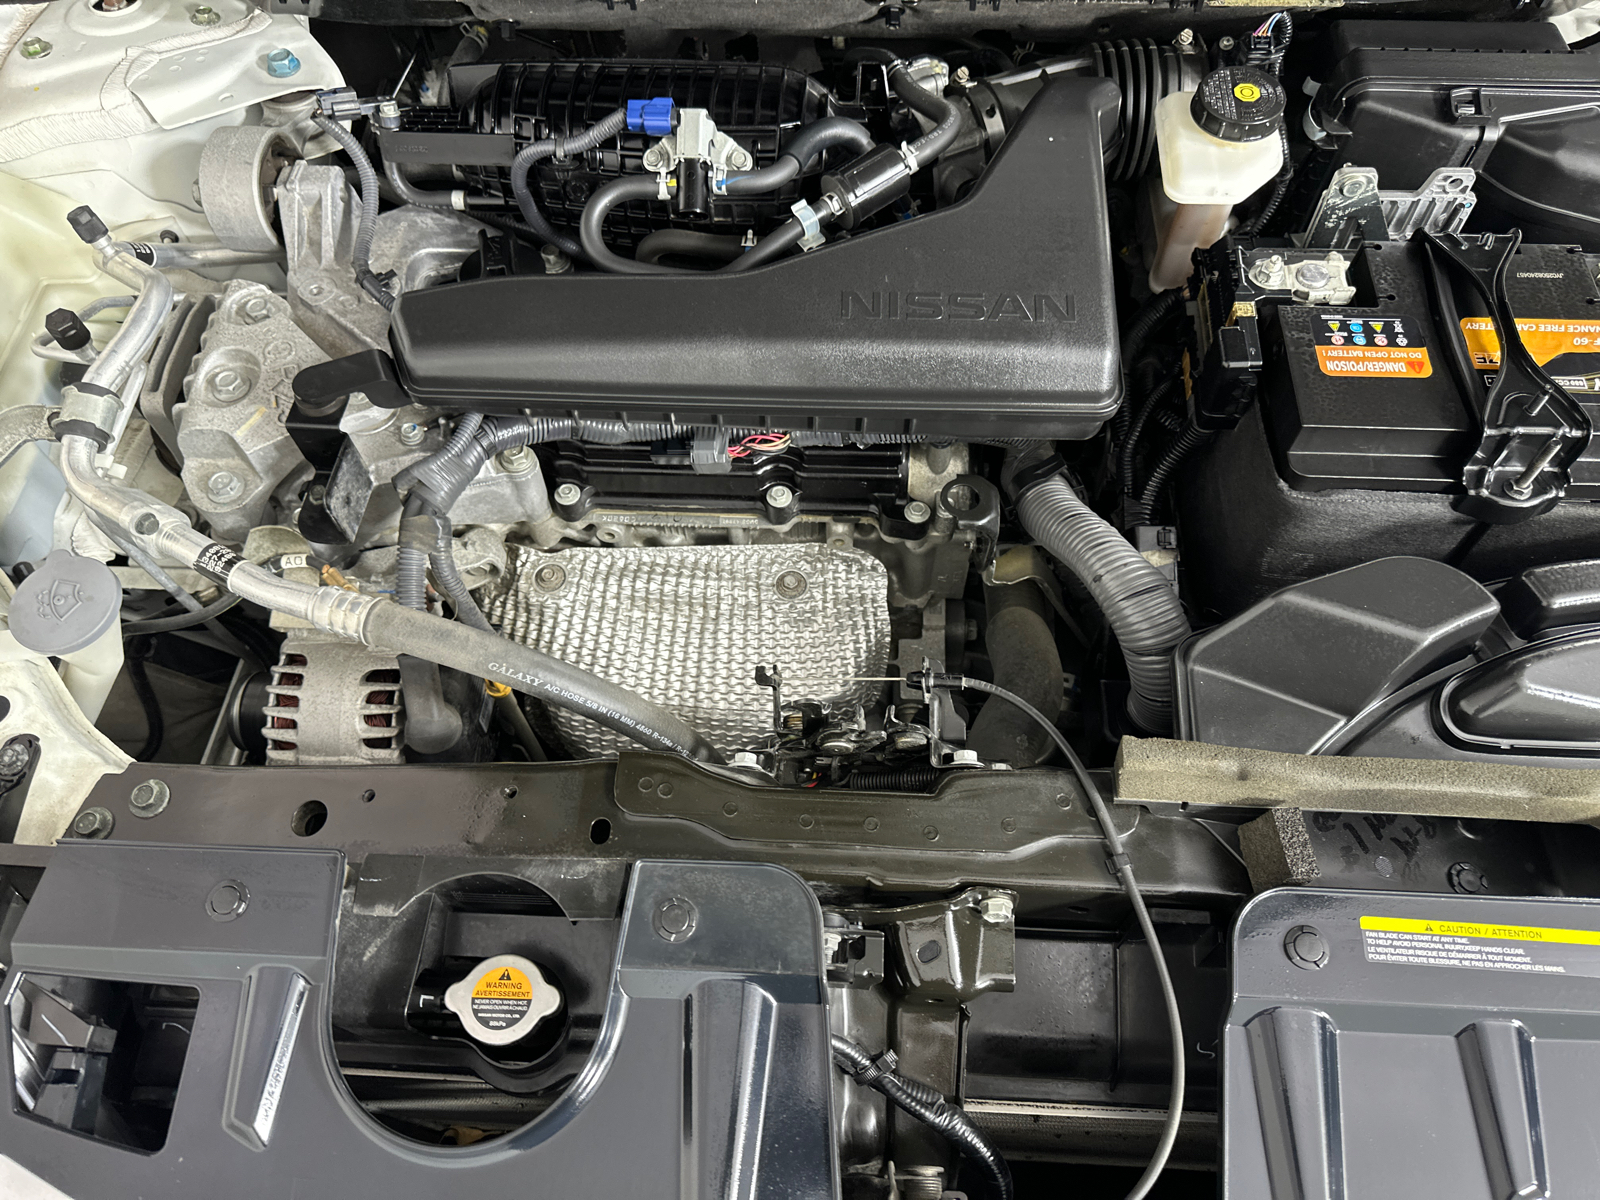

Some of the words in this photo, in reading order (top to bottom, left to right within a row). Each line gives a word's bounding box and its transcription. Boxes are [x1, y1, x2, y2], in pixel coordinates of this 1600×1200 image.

[840, 290, 1077, 323] NISSAN
[1538, 324, 1565, 333] FREE
[1364, 350, 1389, 358] OPEN
[1326, 360, 1407, 373] DANGER/POISON
[488, 662, 544, 687] GALAXY
[544, 683, 560, 694] A/C
[560, 689, 586, 705] HOSE
[585, 699, 598, 711] 5/8
[598, 705, 609, 714] IN
[607, 709, 620, 720] (16
[619, 715, 636, 728] MM)
[1439, 925, 1481, 935] CAUTION
[1491, 928, 1542, 939] ATTENTION
[1375, 947, 1415, 956] VENTILATEUR
[1414, 949, 1439, 957] RISQUE
[1448, 951, 1481, 960] DÉMARRER
[1487, 954, 1503, 962] TOUT
[1411, 941, 1444, 949] PERSONAL
[1503, 947, 1525, 955] CLEAR.
[1368, 953, 1386, 961] POUR
[1387, 954, 1408, 962] ÉVITER
[1471, 960, 1484, 968] PAS
[1493, 962, 1532, 970] APPROCHER
[485, 981, 523, 990] WARNING
[475, 990, 531, 998] AVERTISSEMENT
